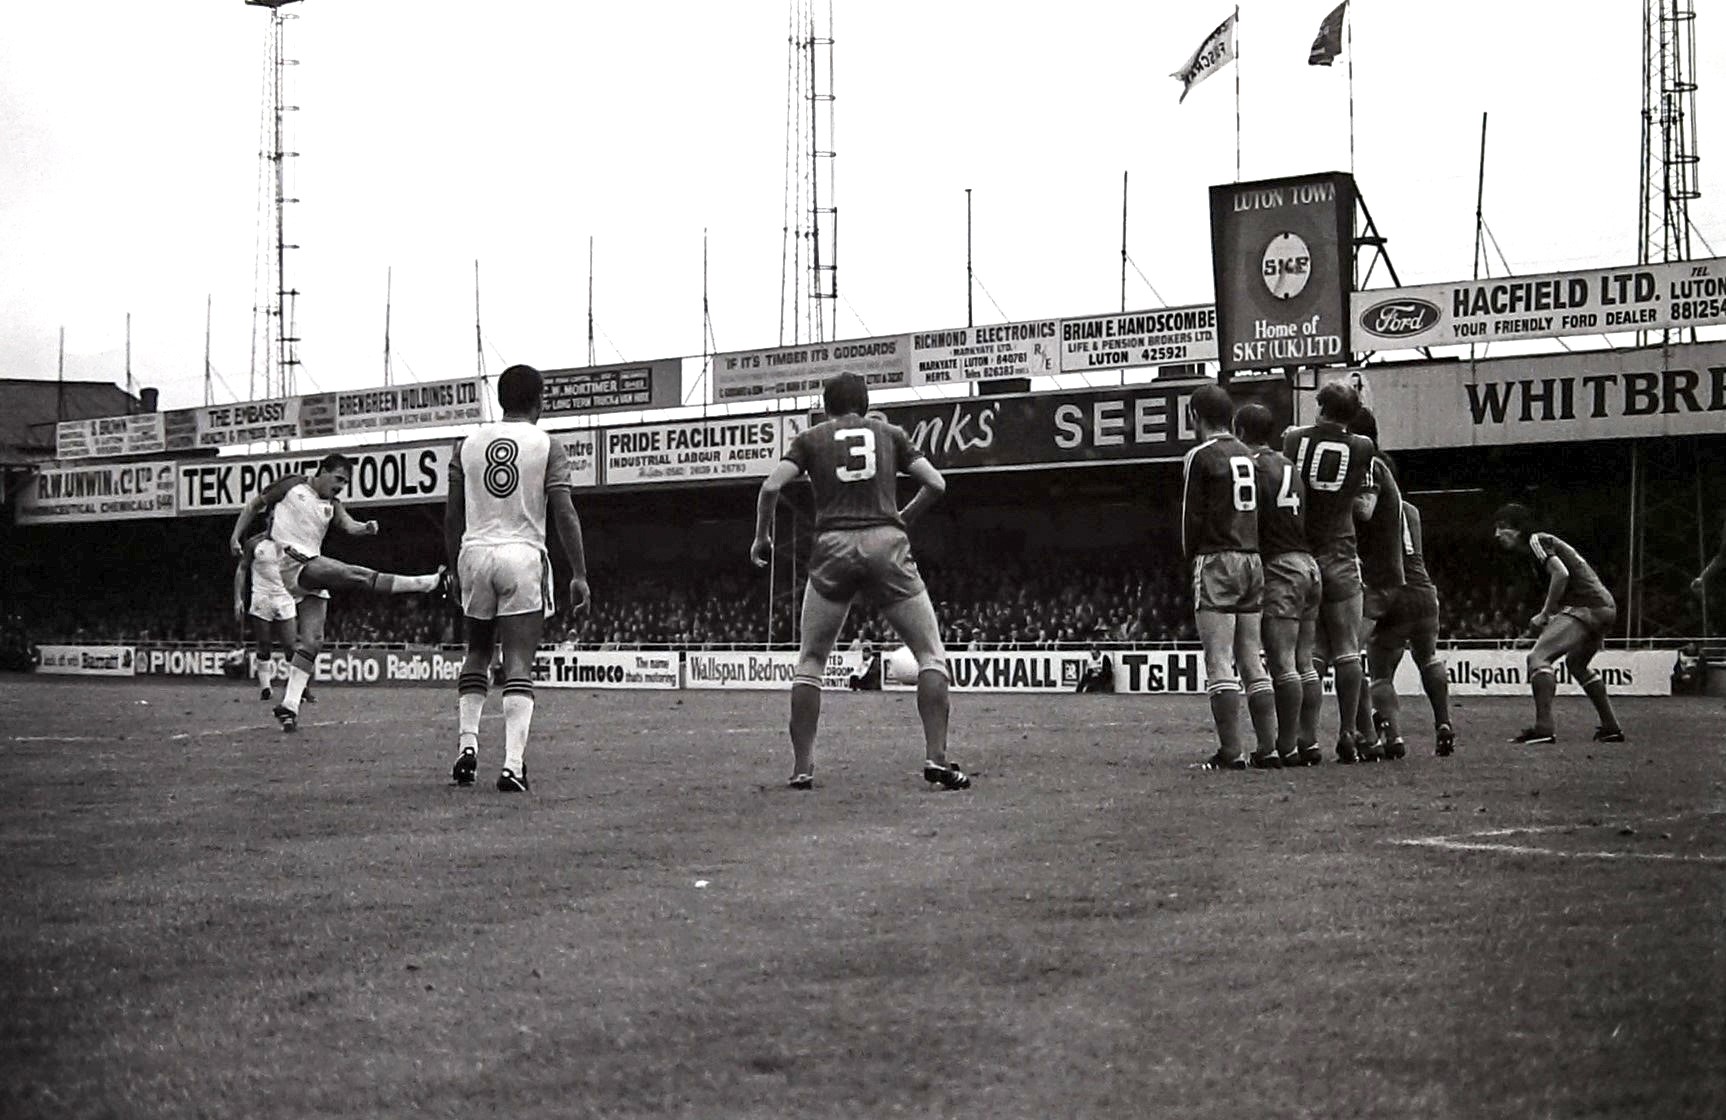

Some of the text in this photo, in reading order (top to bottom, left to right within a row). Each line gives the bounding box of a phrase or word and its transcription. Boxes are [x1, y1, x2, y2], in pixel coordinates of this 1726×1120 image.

[1233, 189, 1283, 212] LUTON
[1453, 272, 1661, 317] HACFIELD LTD.
[1670, 277, 1726, 300] LUTON
[1063, 321, 1103, 341] BRIAN
[1255, 315, 1320, 339] Home of
[1375, 304, 1426, 332] Ford
[1453, 308, 1657, 341] YOUR FRIENDLY FORD DEALER
[914, 322, 1055, 350] RICHMOND ELECTRONICS
[1068, 342, 1089, 353] LIFE
[1092, 341, 1098, 351] &
[1102, 337, 1145, 350] PENSION
[1148, 332, 1192, 345] BROKERS
[766, 350, 808, 366] TIMBER
[1089, 345, 1187, 366] LUTON 425921
[401, 384, 454, 410] HOLDINGS
[208, 408, 231, 428] THE
[563, 440, 593, 457] ntre
[609, 422, 775, 454] PRIDE FACILITIES
[484, 438, 519, 499] 8
[609, 453, 671, 468] INDUSTRIAL
[677, 450, 721, 465] LABOUR
[729, 447, 775, 461] AGENCY
[834, 428, 877, 482] 3
[1297, 437, 1350, 492] 10
[183, 465, 236, 506] TEK
[1230, 456, 1257, 512] 8
[1277, 465, 1300, 516] 4
[151, 651, 226, 676] PIONEE
[315, 653, 380, 682] Echo
[387, 654, 431, 681] Radio
[554, 656, 624, 683] Trimoco
[690, 656, 798, 685] Wallspan Bedroo
[1122, 653, 1198, 692] T&H
[1447, 661, 1520, 689] allspan
